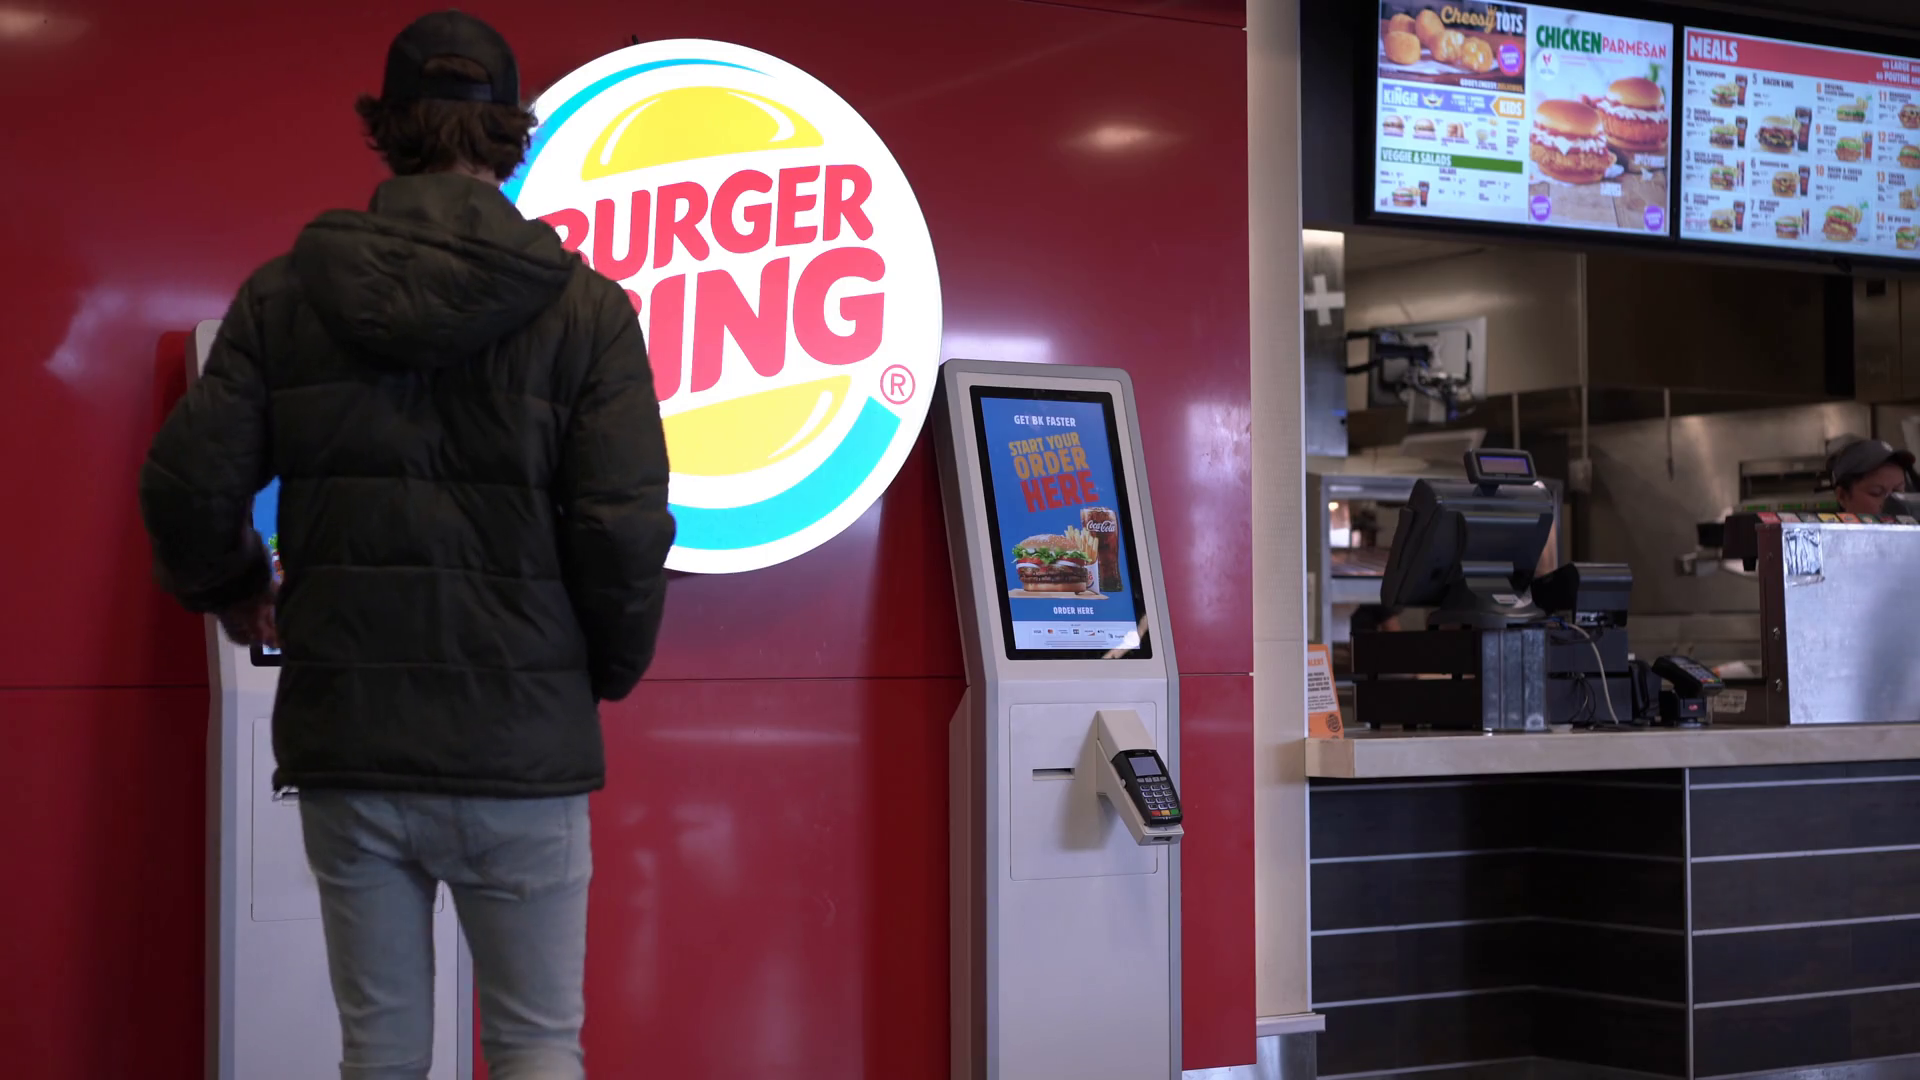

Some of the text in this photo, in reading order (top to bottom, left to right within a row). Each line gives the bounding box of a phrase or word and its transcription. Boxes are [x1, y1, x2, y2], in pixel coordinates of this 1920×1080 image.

[1441, 6, 1523, 33] Cheesy TOTS
[1536, 25, 1666, 58] CHICKEN PARMESAN
[1690, 36, 1738, 63] MEALS
[1383, 88, 1409, 106] KING
[1500, 100, 1522, 115] KIDS
[1382, 150, 1452, 166] VEGGIE & SALADS
[538, 164, 874, 282] BURGER
[620, 247, 886, 402] ING
[1014, 415, 1076, 427] GET BK FASTER
[1008, 432, 1080, 456] START YOUR
[1014, 446, 1090, 480] ORDER
[1021, 470, 1099, 513] HERE
[1053, 606, 1094, 615] ORDER HERE
